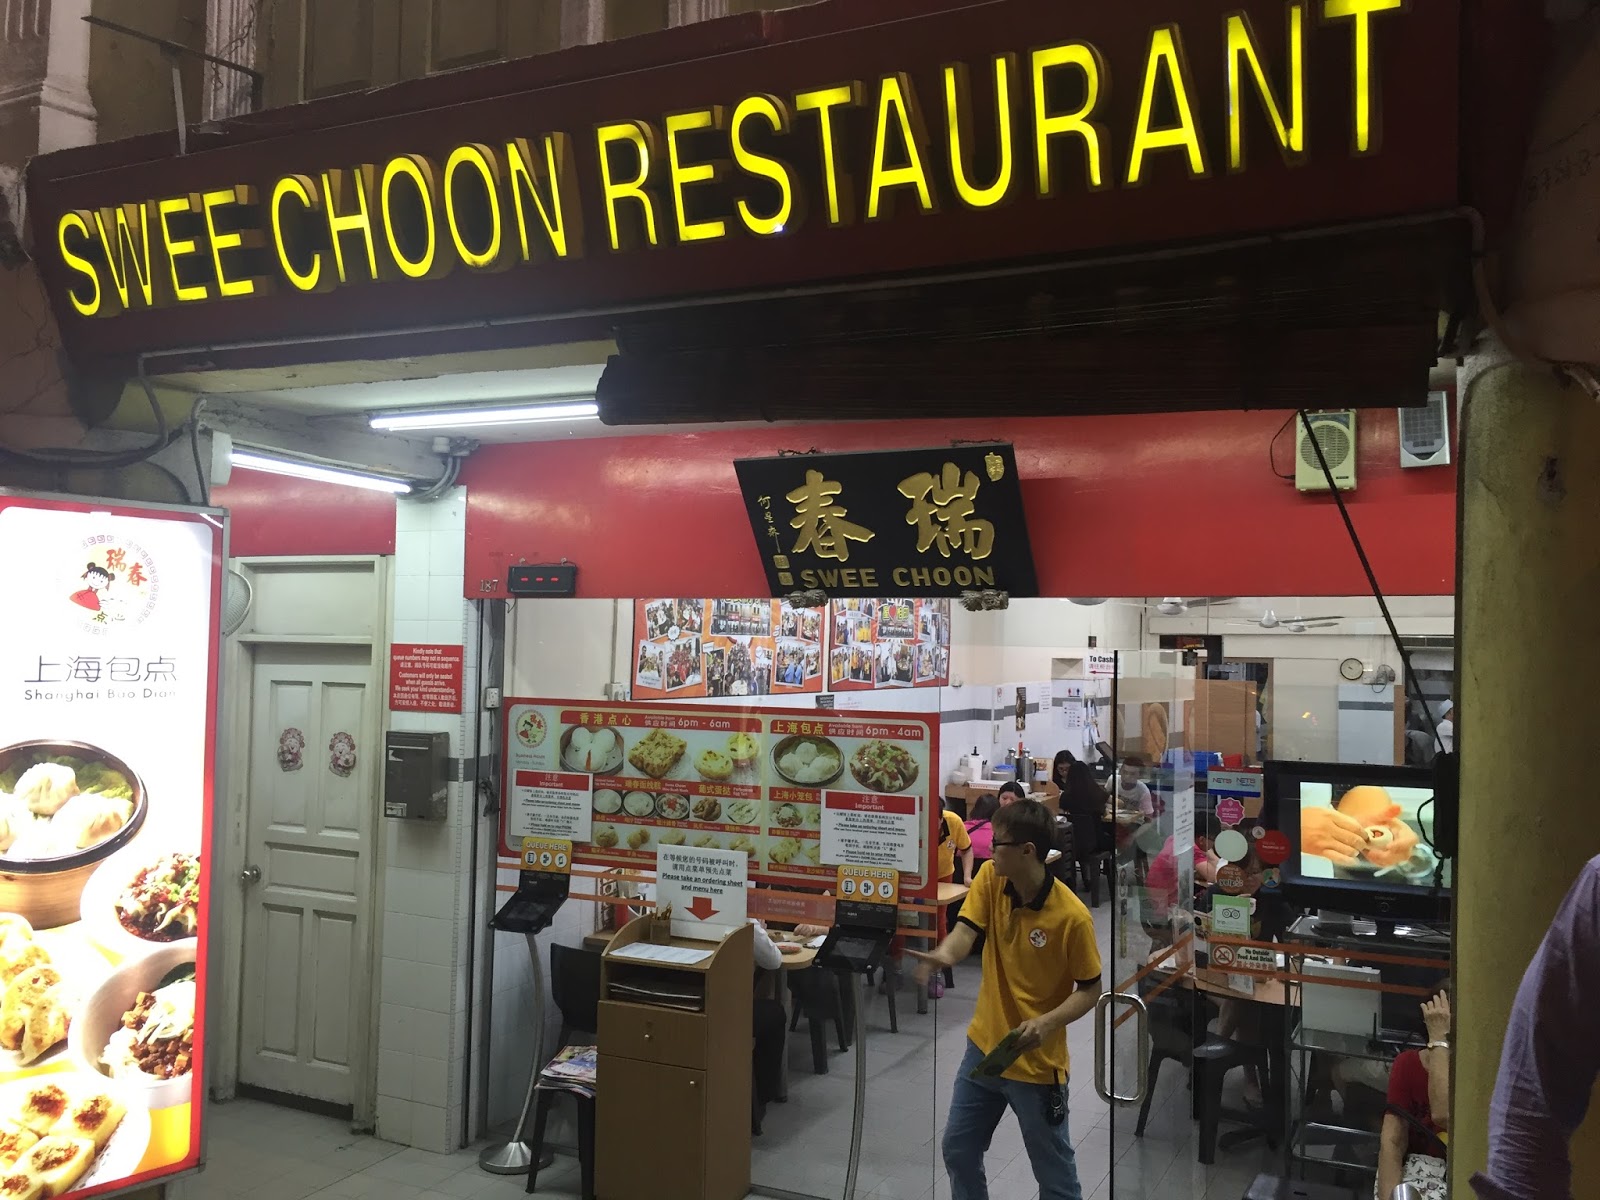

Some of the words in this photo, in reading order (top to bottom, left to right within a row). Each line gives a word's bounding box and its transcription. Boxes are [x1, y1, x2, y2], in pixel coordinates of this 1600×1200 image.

[57, 190, 257, 315] SWEE
[271, 136, 568, 291] CHOON
[596, 0, 1402, 250] RESTAURANT
[799, 567, 880, 589] SWEE
[892, 565, 995, 587] CHOON
[479, 579, 499, 593] 187
[24, 654, 177, 683] 上海包点
[24, 688, 99, 703] Shanghai
[580, 713, 631, 726] 香港点心
[678, 718, 698, 727] 6pm
[710, 719, 730, 728] 6am
[773, 720, 824, 735] 上海包点
[866, 726, 888, 736] 6pm
[897, 726, 921, 736] 4am
[774, 790, 813, 800] 上海小笼包
[672, 864, 732, 876] 请用点菜单预先点菜
[842, 868, 869, 877] QUEUE
[871, 870, 894, 879] HERE!
[702, 877, 726, 886] ordering
